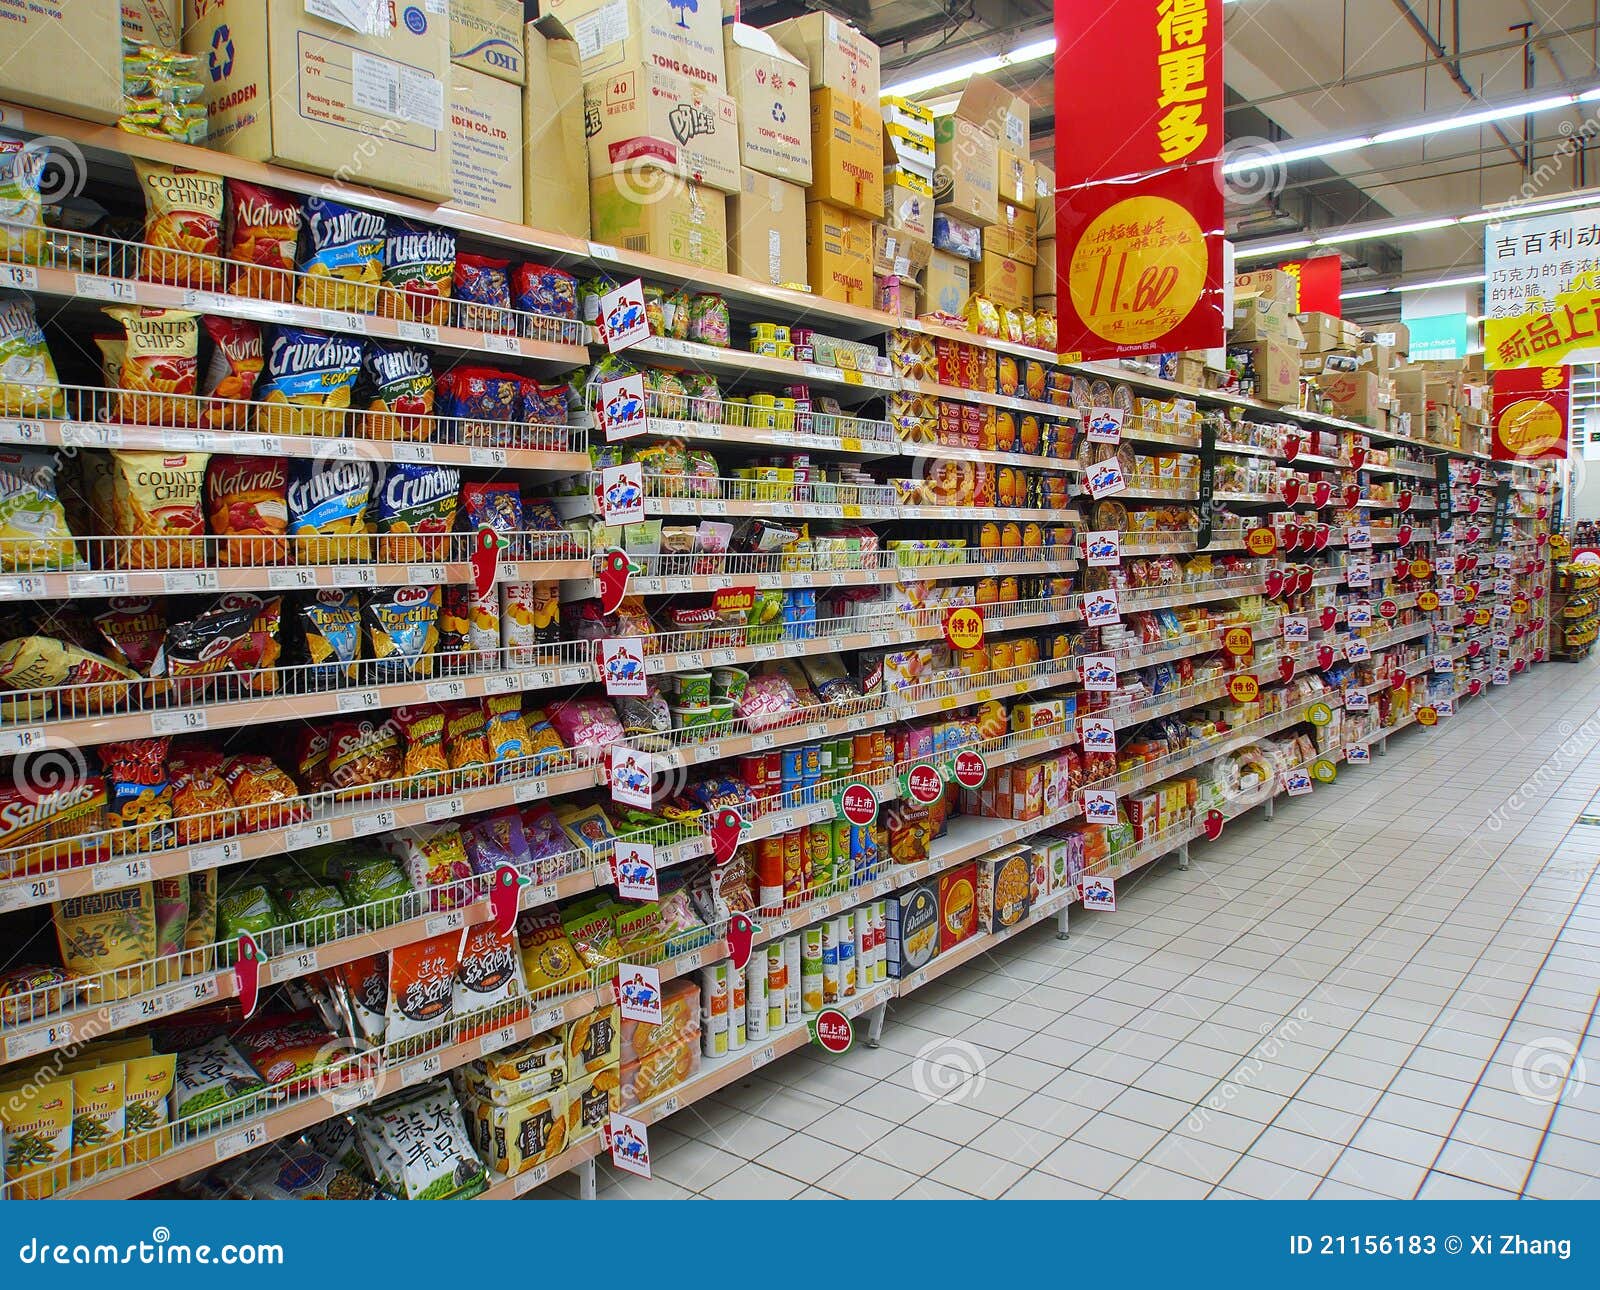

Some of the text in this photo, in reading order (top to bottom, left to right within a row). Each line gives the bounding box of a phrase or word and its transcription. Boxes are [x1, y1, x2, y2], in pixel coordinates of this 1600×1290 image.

[304, 51, 325, 63] Goods
[652, 54, 718, 84] TONG GARDEN
[614, 82, 626, 95] 40
[1156, 0, 1208, 163] 得更多
[219, 83, 257, 112] GARDEN
[307, 92, 330, 106] Packing
[307, 106, 329, 118] Expired
[723, 107, 731, 117] 40
[759, 127, 775, 138] TONG
[747, 142, 759, 151] Pack
[147, 175, 222, 196] COUNTR
[167, 189, 215, 209] CHIPS
[1496, 224, 1600, 258] 吉百利动
[135, 334, 185, 349] CHIPS
[1117, 344, 1141, 352] Auchan
[210, 461, 285, 500] Naturals
[397, 587, 426, 602] Chio
[717, 592, 751, 606] HARIBO
[380, 606, 438, 624] Tortilla
[101, 617, 167, 635] Tortilla
[952, 618, 979, 633] 特价
[957, 763, 981, 772] 新上市
[911, 776, 938, 788] 新上市
[845, 797, 872, 809] 新上市
[63, 804, 97, 823] Sticks
[621, 911, 657, 932] HARIBO
[820, 1023, 847, 1035] 新上市
